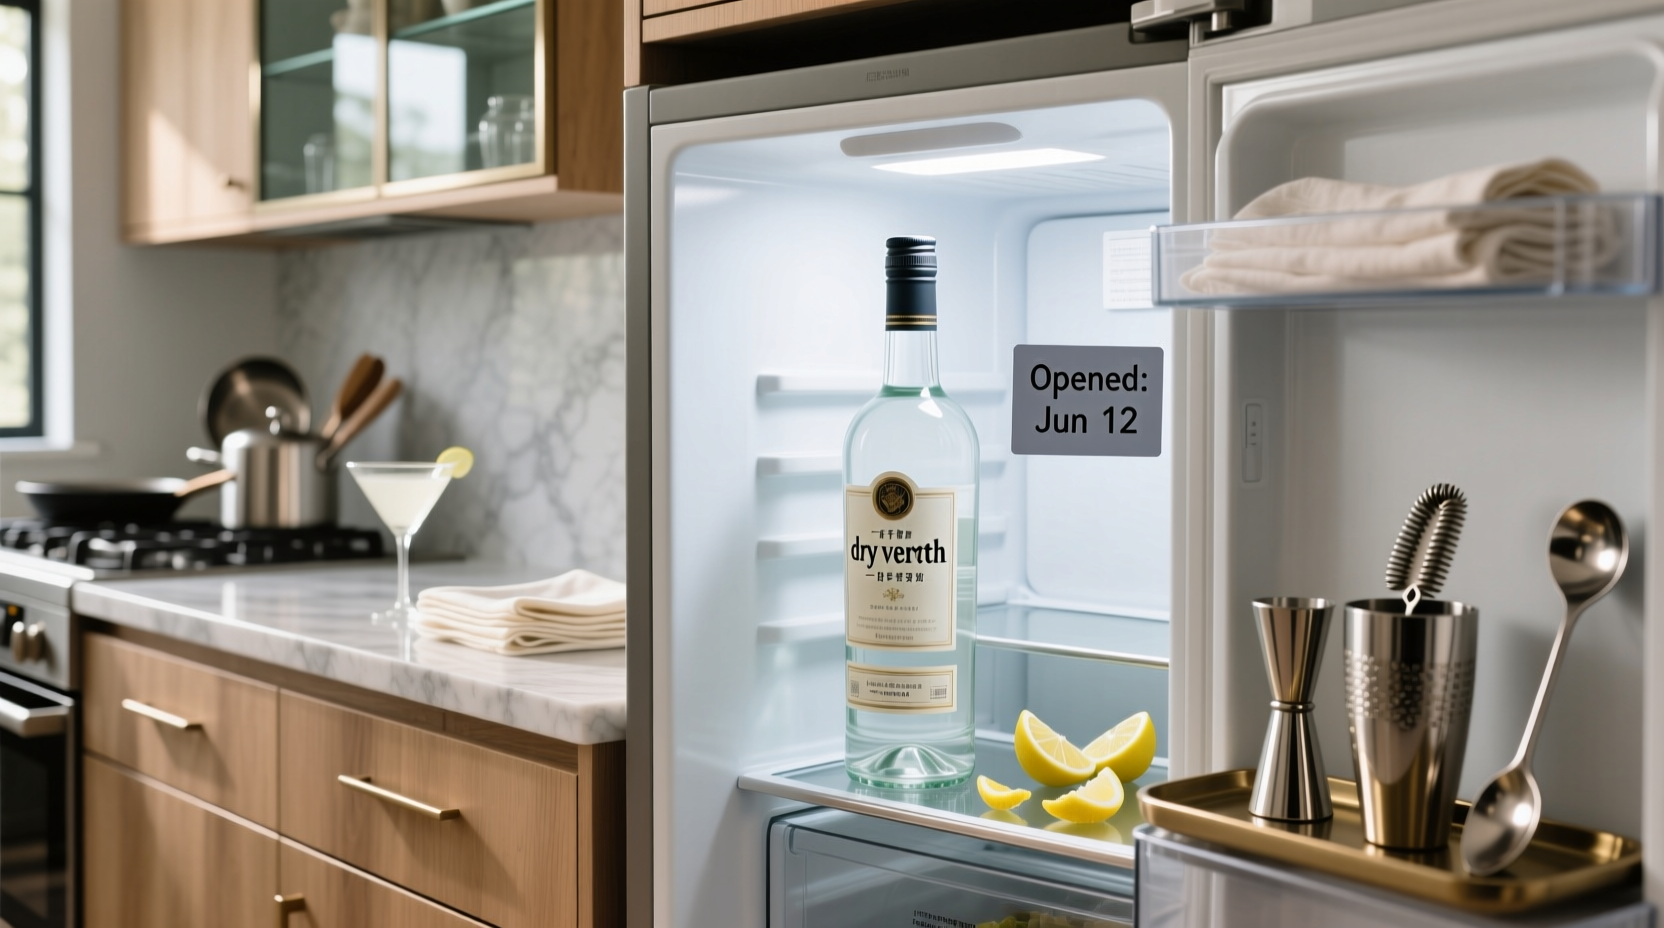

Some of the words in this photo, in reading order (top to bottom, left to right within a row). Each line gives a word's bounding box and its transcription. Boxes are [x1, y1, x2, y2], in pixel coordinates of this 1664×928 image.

[1030, 363, 1147, 400] Opened:
[1035, 405, 1088, 434] Jun
[1103, 406, 1138, 434] 12
[851, 535, 878, 569] dry
